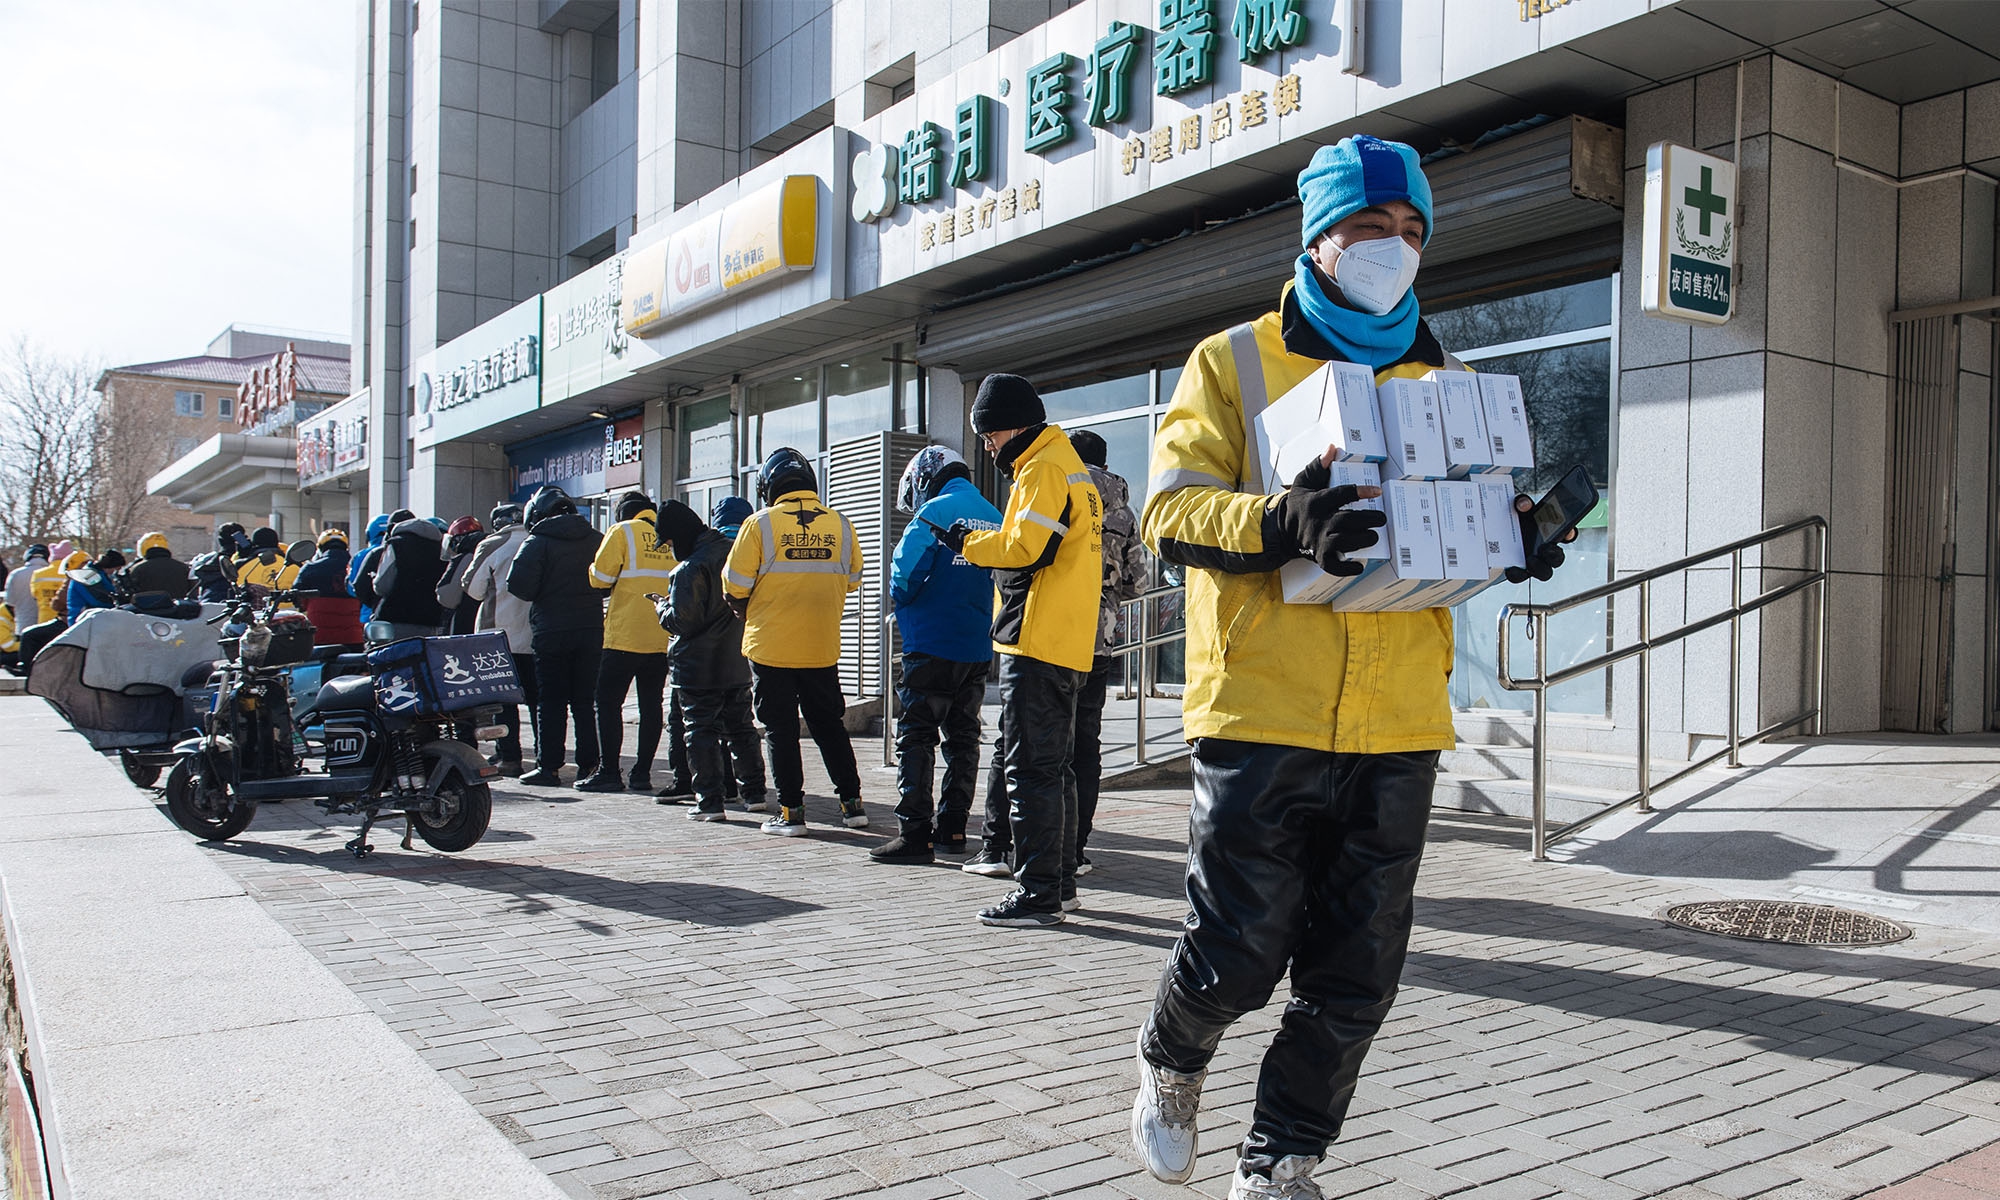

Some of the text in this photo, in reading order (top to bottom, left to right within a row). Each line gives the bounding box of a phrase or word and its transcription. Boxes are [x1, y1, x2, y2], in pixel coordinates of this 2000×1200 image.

[1121, 73, 1302, 176] 护理用品连锁
[920, 178, 1041, 252] 家庭医疗器械
[1671, 267, 1729, 304] 夜间售药24h
[605, 434, 642, 467] 早阳包子
[781, 533, 836, 547] 美团外卖
[792, 549, 826, 559] 美团专送
[471, 650, 510, 672] 达达
